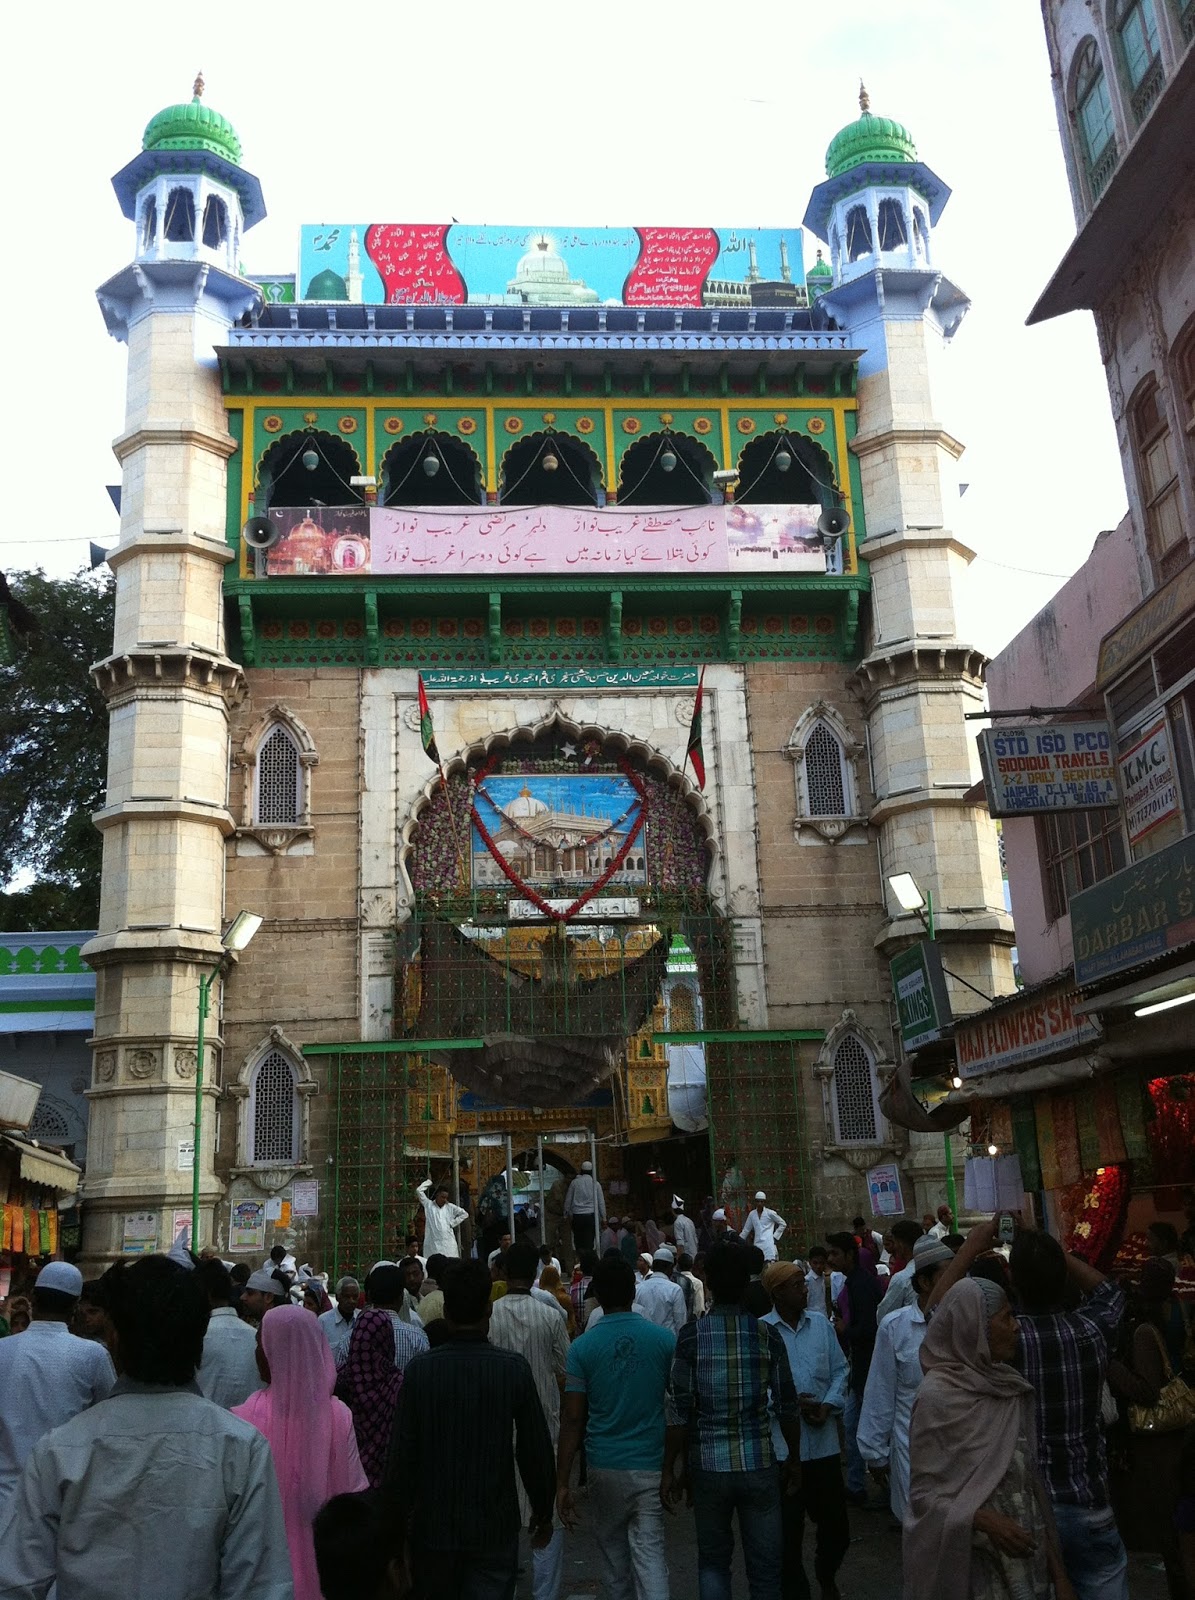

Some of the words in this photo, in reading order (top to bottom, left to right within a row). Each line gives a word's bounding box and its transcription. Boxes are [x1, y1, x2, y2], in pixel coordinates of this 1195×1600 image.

[426, 515, 471, 538] غریب
[597, 515, 640, 537] غریب
[411, 544, 455, 567] غریب
[497, 540, 529, 564] کوئی
[686, 540, 717, 563] کوئی
[993, 737, 1029, 756] STD
[1036, 734, 1066, 754] ISD
[1073, 731, 1110, 751] PCO
[997, 755, 1050, 773] SIDDIQUI
[1053, 751, 1110, 769] TRAVELS
[1123, 741, 1166, 790] K.M.C.
[1027, 771, 1056, 785] DAILY
[1062, 767, 1116, 782] SERVICES
[1003, 784, 1039, 798] JAIPUR
[1085, 780, 1113, 792] AGA
[1073, 791, 1107, 805] SURAT
[1077, 901, 1169, 961] DARBAR
[1177, 887, 1194, 917] S
